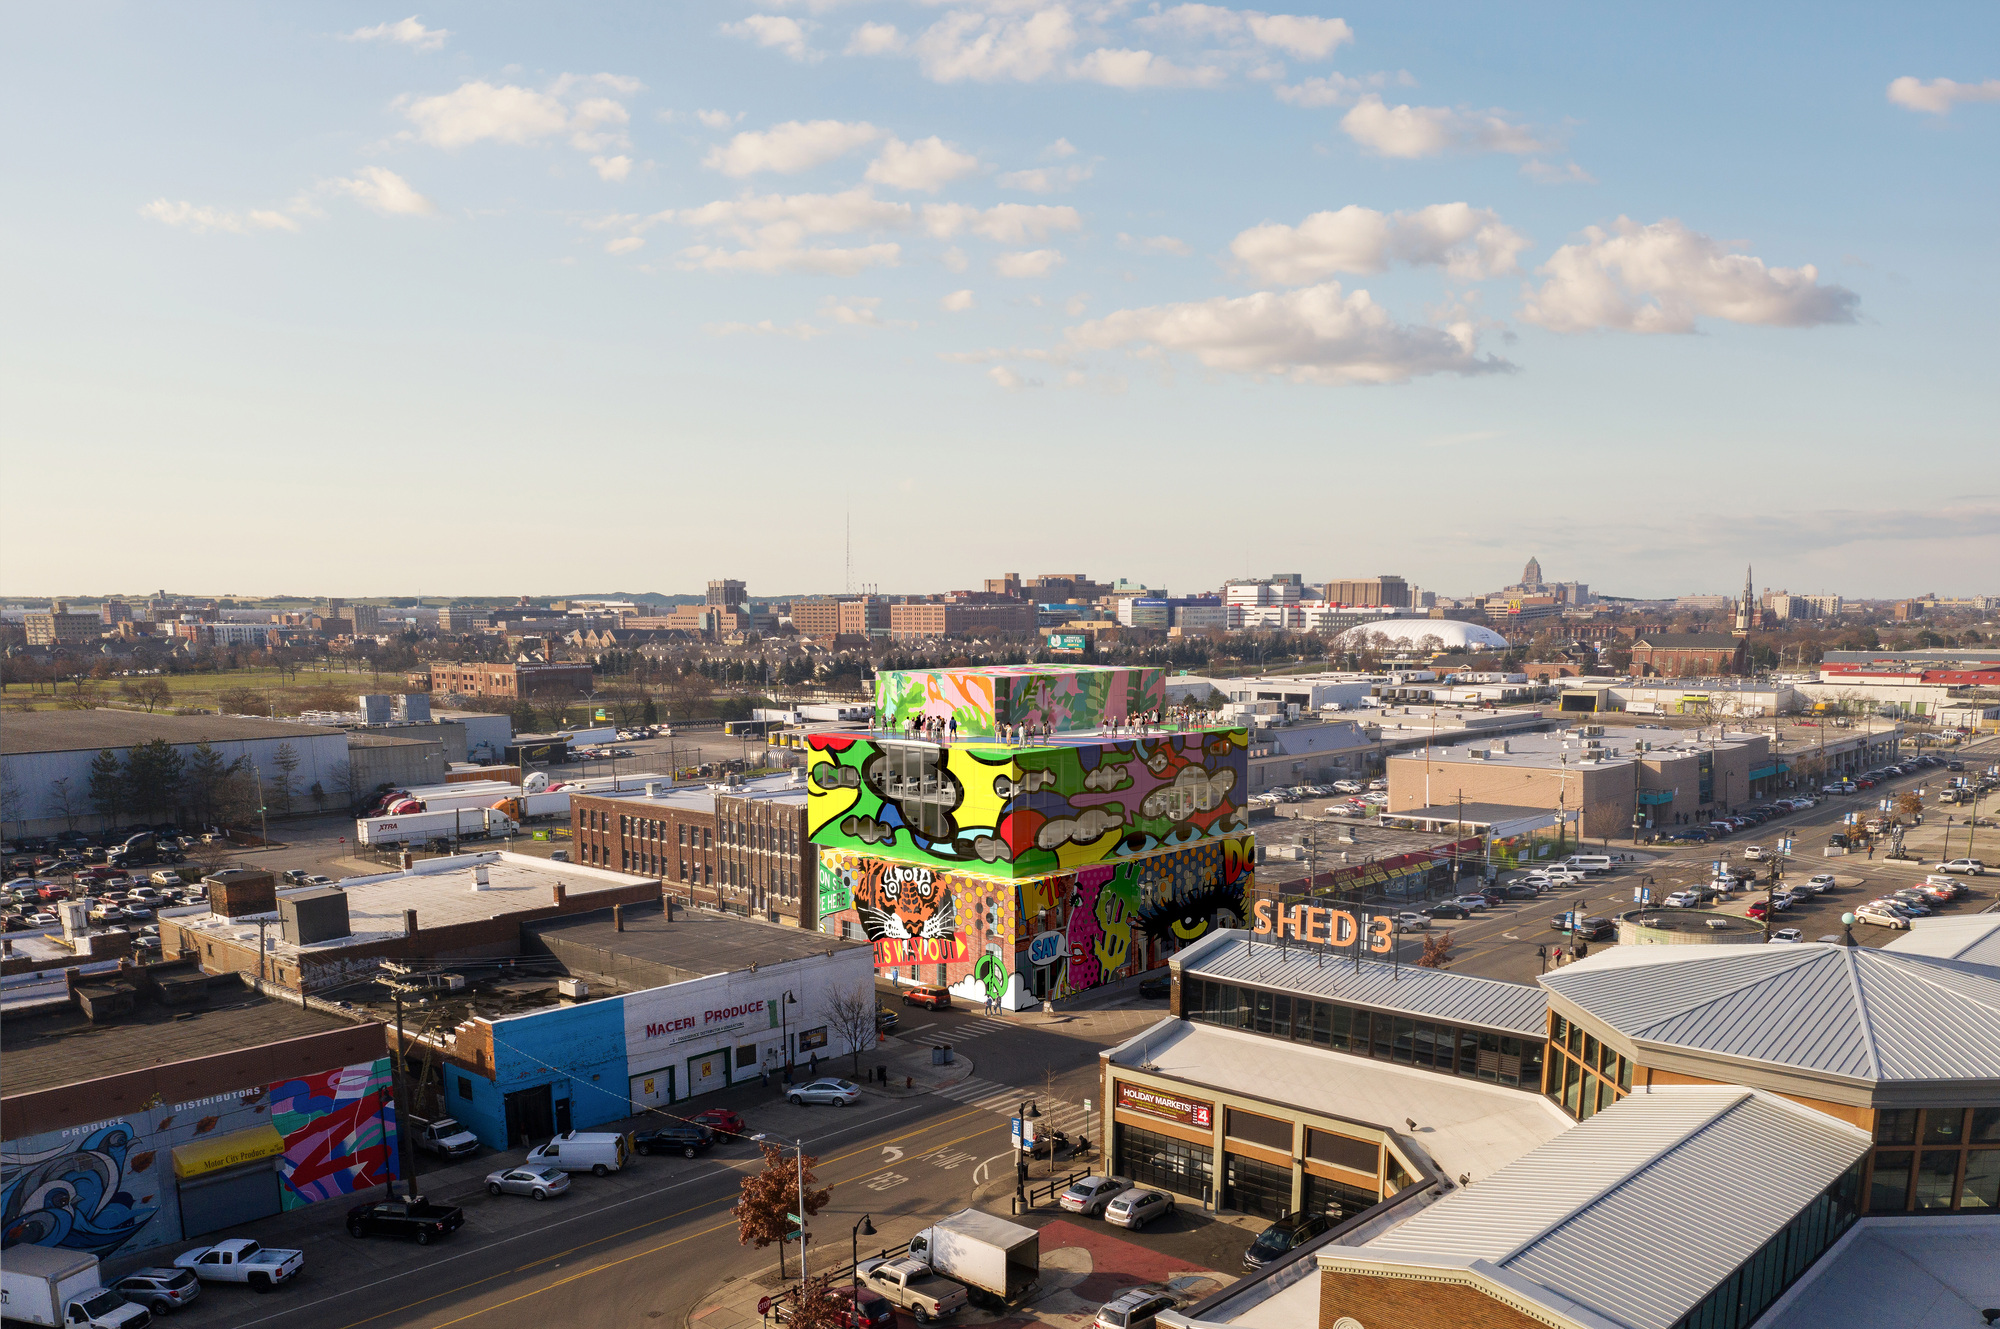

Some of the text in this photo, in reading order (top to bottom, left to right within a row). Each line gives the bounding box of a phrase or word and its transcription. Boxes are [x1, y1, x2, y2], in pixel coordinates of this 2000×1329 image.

[378, 823, 398, 832] XTRA
[832, 877, 843, 891] ST
[827, 891, 846, 910] HERE
[1253, 898, 1394, 953] SHED 3
[874, 937, 954, 964] HIS WAY OUT
[1031, 934, 1060, 962] SAY
[646, 1000, 764, 1038] MACERI PRODUCE
[174, 1086, 261, 1112] DISTRIBUTORS
[1123, 1088, 1155, 1103] HOLIDAY
[1155, 1096, 1192, 1112] MARKETS!
[61, 1117, 125, 1138] PRODUCE
[204, 1158, 225, 1170] Motor
[225, 1154, 239, 1165] City
[240, 1148, 266, 1161] Produce
[916, 1146, 978, 1169] X-ING
[858, 1171, 909, 1191] PED
[758, 1299, 771, 1311] STOP
